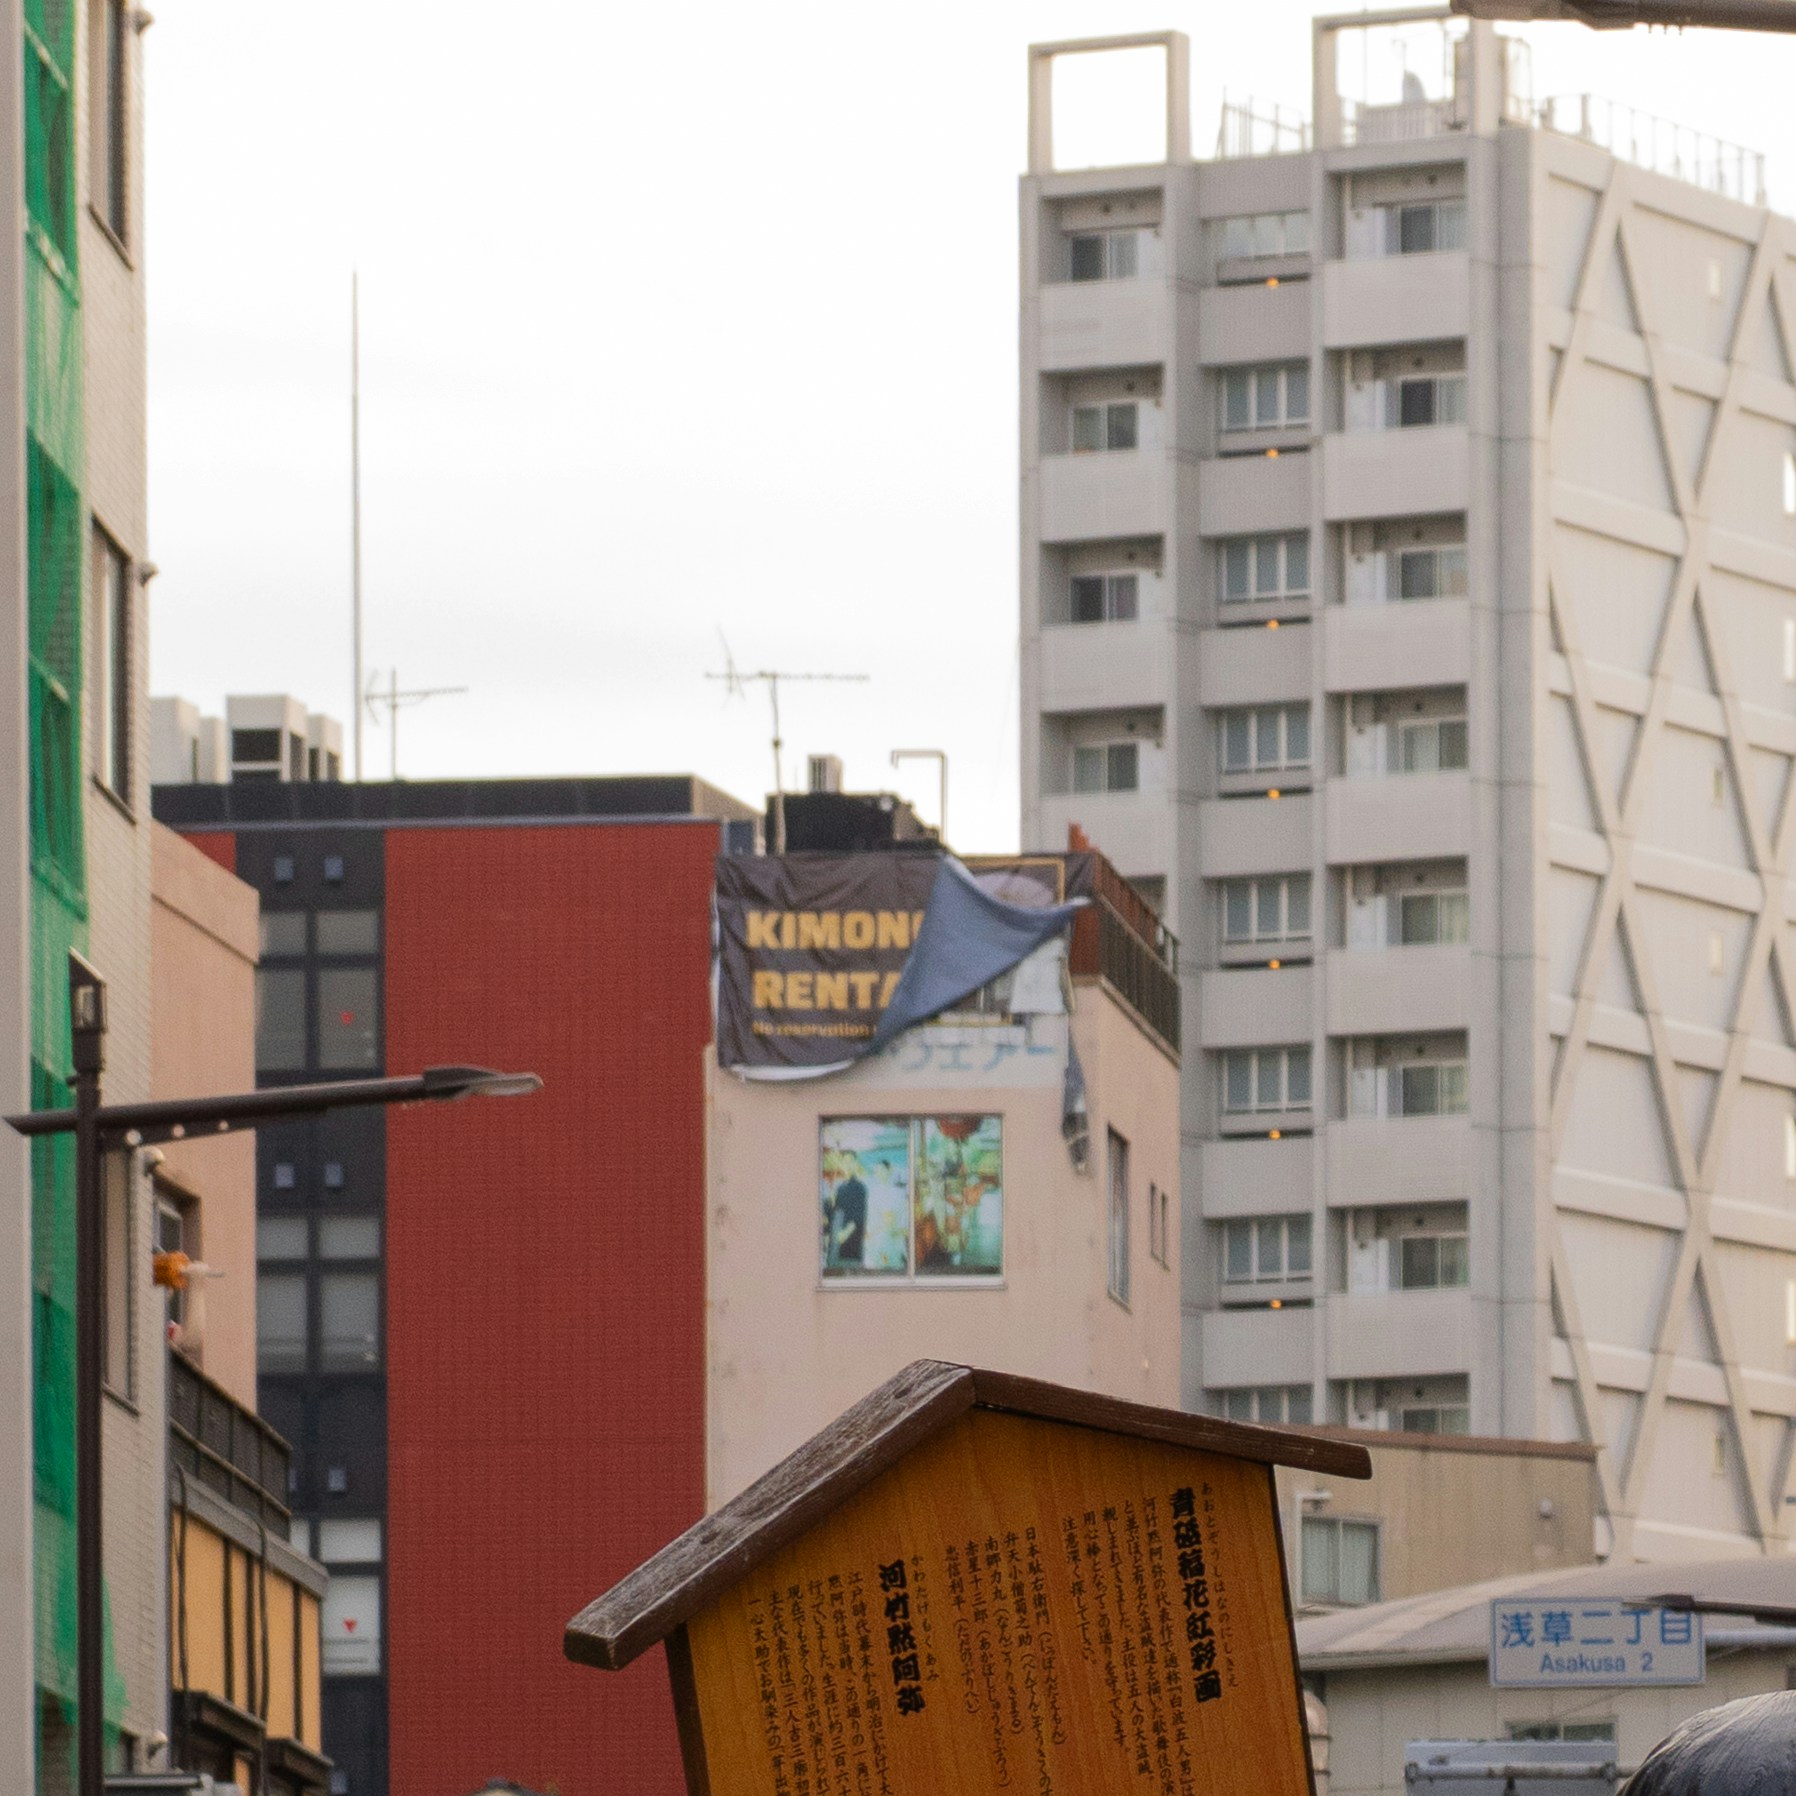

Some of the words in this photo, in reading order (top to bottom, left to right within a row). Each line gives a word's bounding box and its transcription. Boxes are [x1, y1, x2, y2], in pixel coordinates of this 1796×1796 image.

[746, 909, 925, 950] KIMON
[877, 1557, 926, 1717] 河竹黙阿弥
[1500, 1609, 1693, 1649] 浅草二丁目
[1540, 1652, 1626, 1674] Asakusa
[1641, 1653, 1654, 1673] 2
